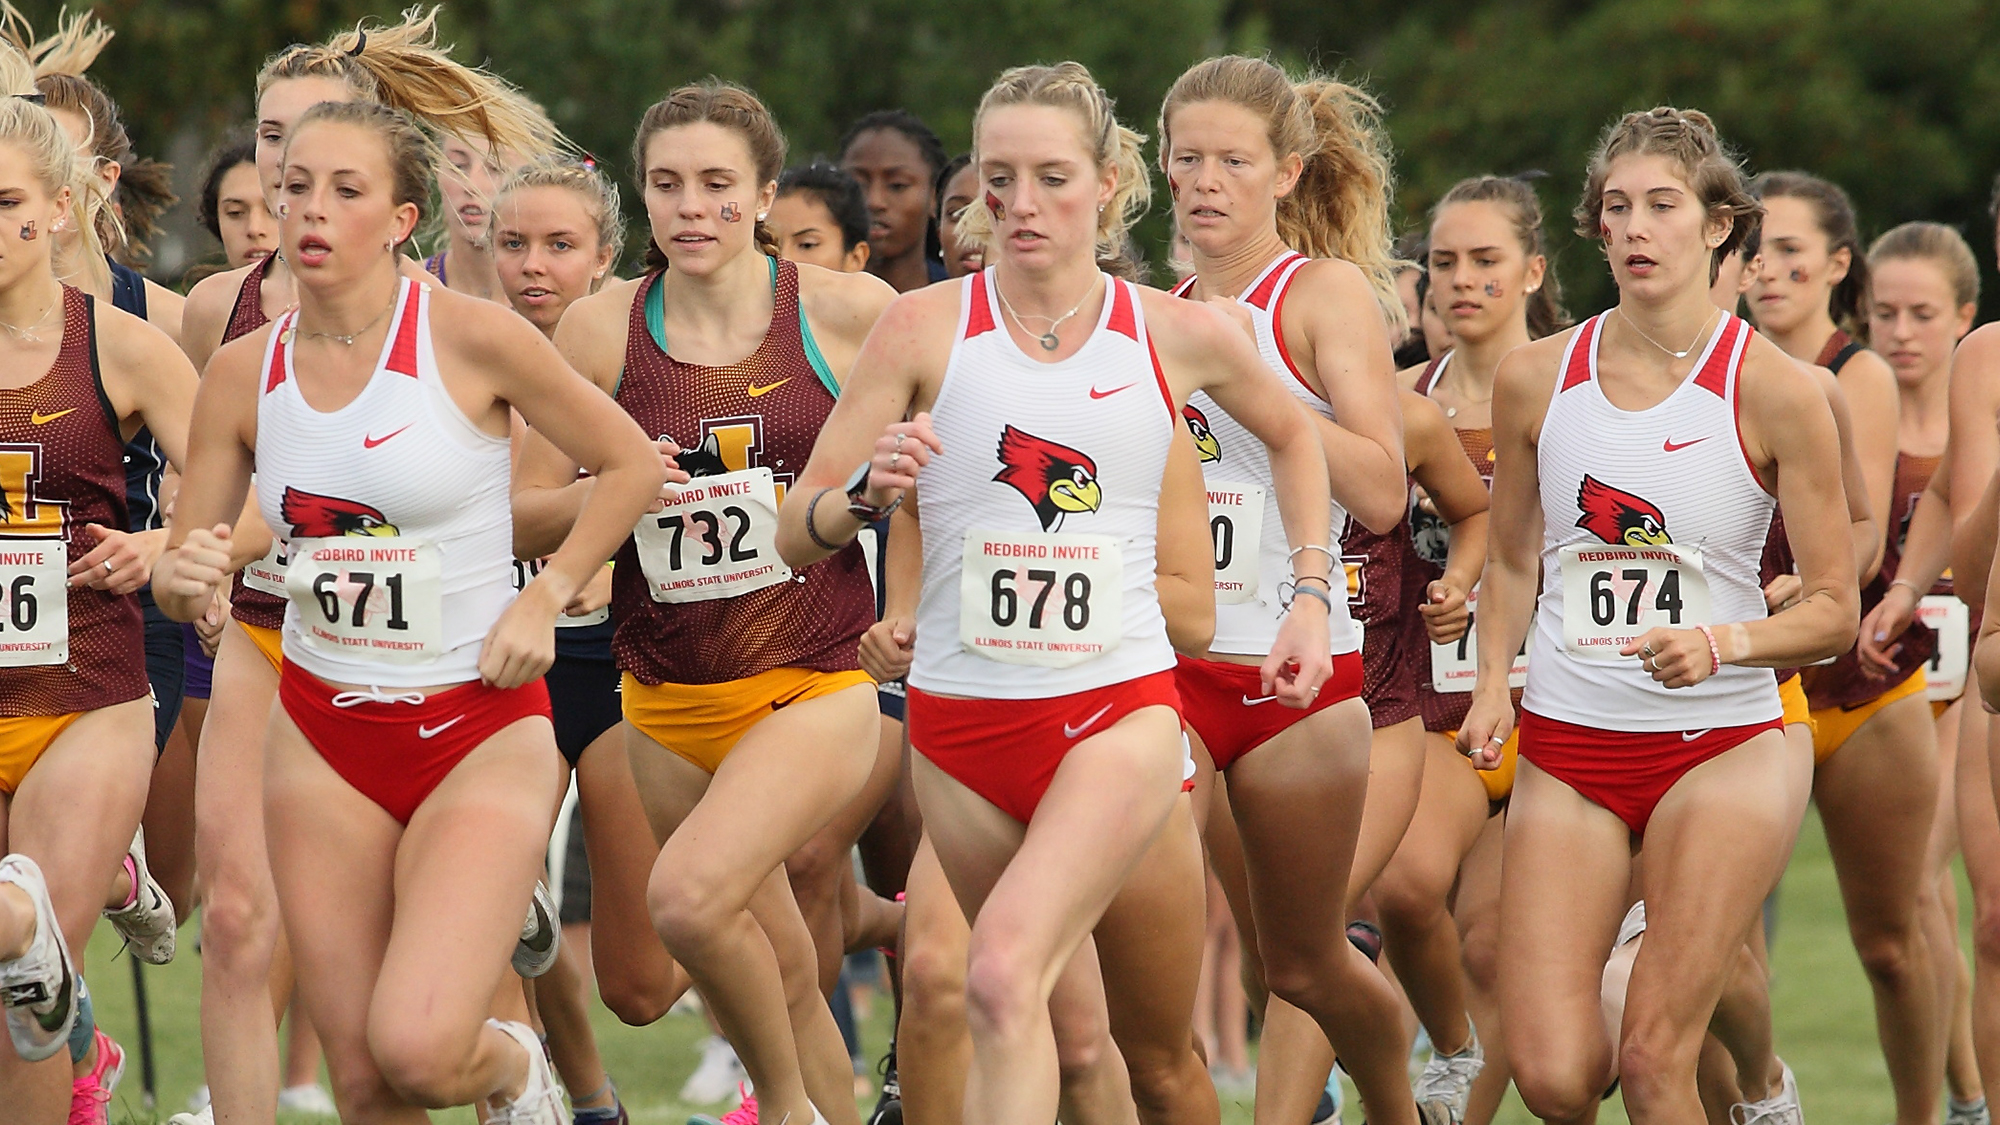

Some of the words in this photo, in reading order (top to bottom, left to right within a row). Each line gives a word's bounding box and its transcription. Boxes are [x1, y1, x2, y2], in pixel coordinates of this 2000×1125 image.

[664, 489, 704, 507] DBIRD
[708, 481, 751, 498] INVITE
[1207, 491, 1243, 506] NVITE
[657, 506, 758, 571] 732
[0, 552, 44, 566] INVITE
[370, 549, 416, 562] INVITE
[984, 542, 1047, 558] REDBIRD
[1053, 547, 1100, 560] INVITE
[1578, 551, 1637, 562] REDBIRD
[1641, 551, 1682, 564] INVITE
[660, 579, 695, 591] ILLINOIS
[697, 575, 722, 587] STATE
[724, 565, 774, 583] UNIVERSITY
[1214, 581, 1244, 591] ERSITY
[313, 572, 408, 630] 671
[991, 568, 1091, 631] 678
[1590, 569, 1683, 626] 674
[312, 626, 340, 644] ILLINOIS
[342, 637, 369, 647] STATE
[372, 640, 425, 651] UNIVERSITY
[975, 637, 1013, 649] ILLINOIS
[1016, 641, 1044, 650] STATE
[1047, 643, 1104, 654] UNIVERSITY
[1577, 637, 1613, 647] ILLINOIS
